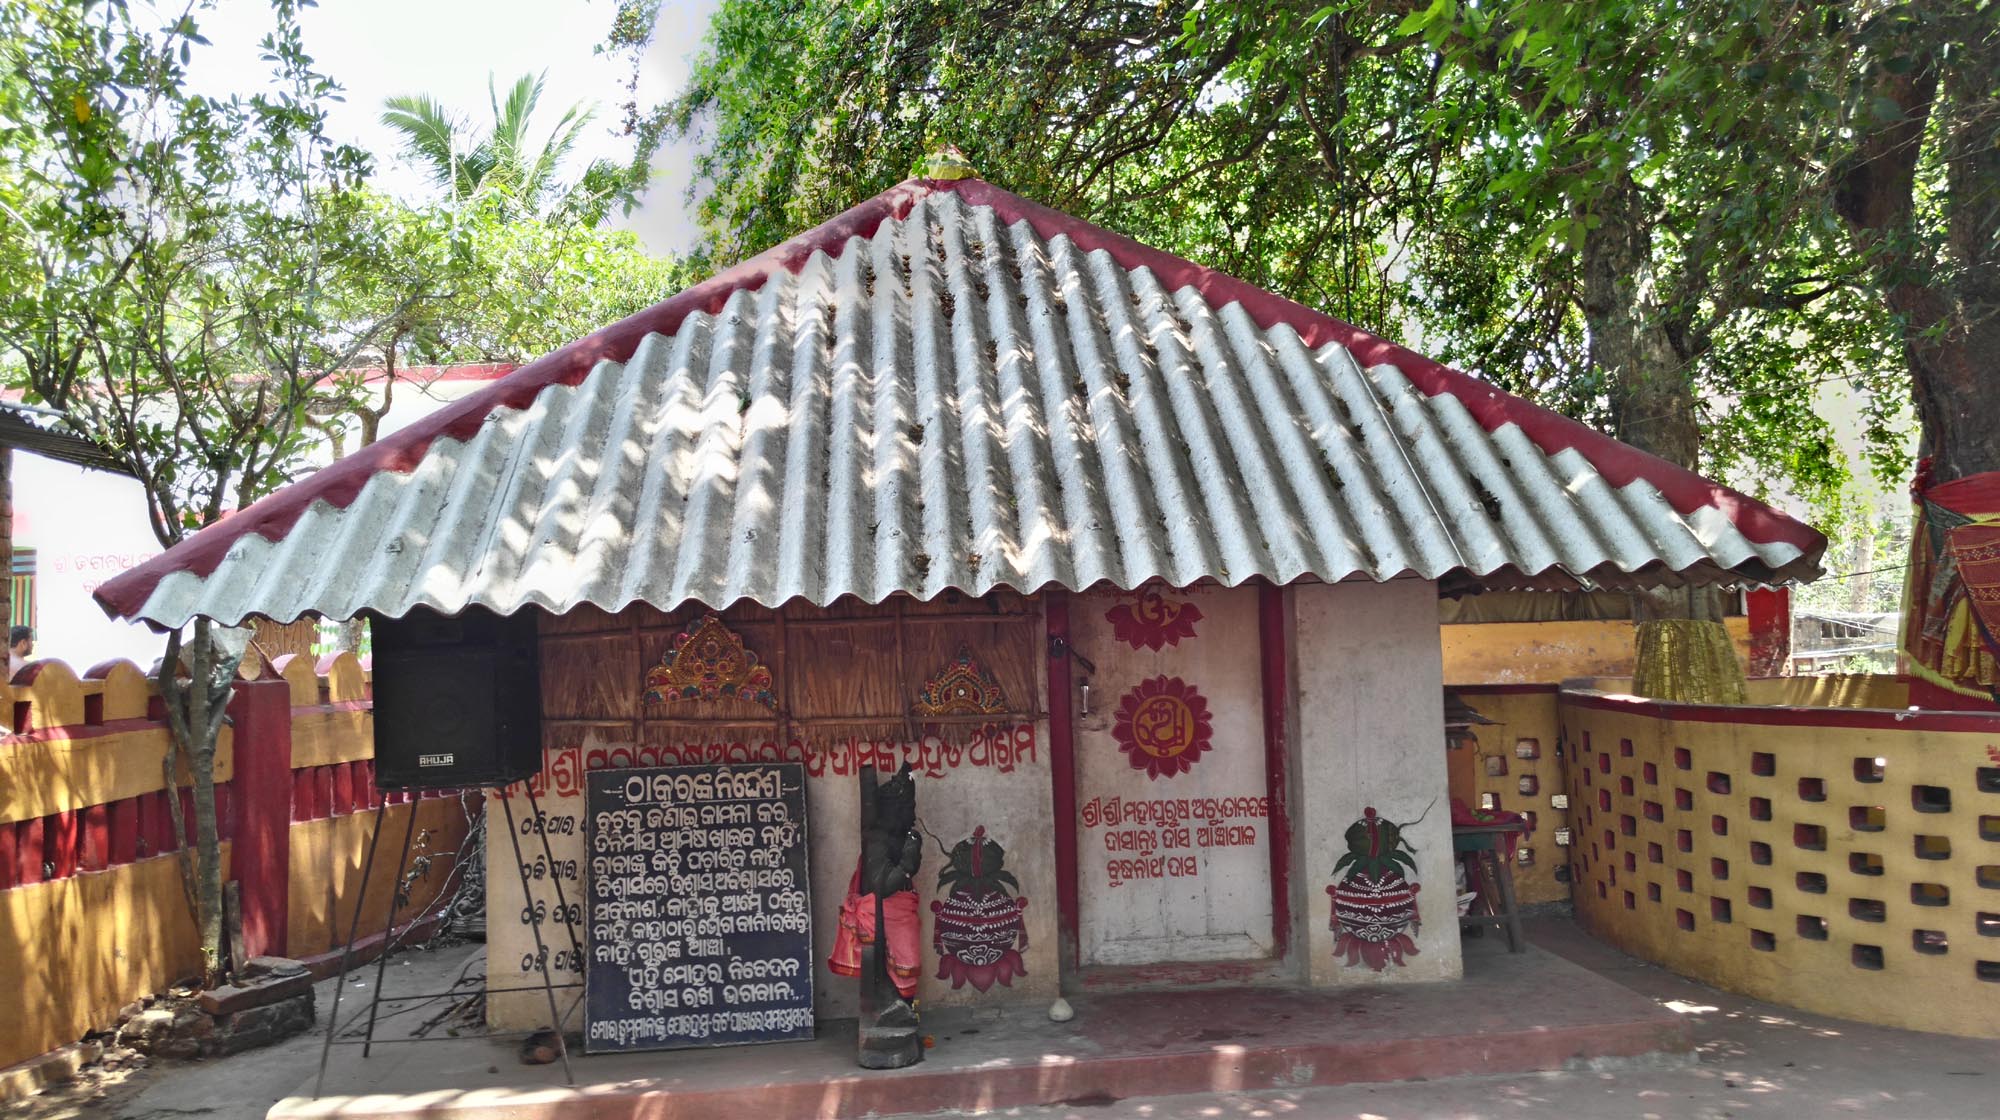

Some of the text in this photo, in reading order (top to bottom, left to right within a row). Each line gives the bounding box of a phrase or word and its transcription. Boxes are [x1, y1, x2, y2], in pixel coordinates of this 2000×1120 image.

[419, 756, 454, 764] AHUJA
[969, 724, 1037, 774] ଆଶ୍ରମ
[625, 771, 713, 807] ଠାକୁରଙ୍କ
[647, 807, 698, 828] ଜଣାଇ
[701, 804, 751, 824] କାମନା
[1081, 797, 1102, 828] ଶ୍ରୀ
[1102, 796, 1123, 826] ଶ୍ରୀ
[1123, 799, 1190, 828] ମହାପୁରୁଷ
[660, 826, 707, 849] ଆମିଷ
[709, 827, 756, 848] ଖାଇବ
[1162, 828, 1191, 849] ଦାସ
[593, 854, 648, 877] ବାବାଙ୍କୁ
[652, 849, 682, 876] କିଛି
[687, 846, 746, 871] ପଚାରିବ
[1167, 856, 1198, 877] ଦାସ
[667, 896, 720, 919] କାହାକୁ
[632, 918, 698, 942] କାହାଠାରୁ
[663, 963, 724, 986] ମୋହର
[728, 956, 800, 980] ନିବେଦନ
[682, 987, 713, 1008] ରଖ
